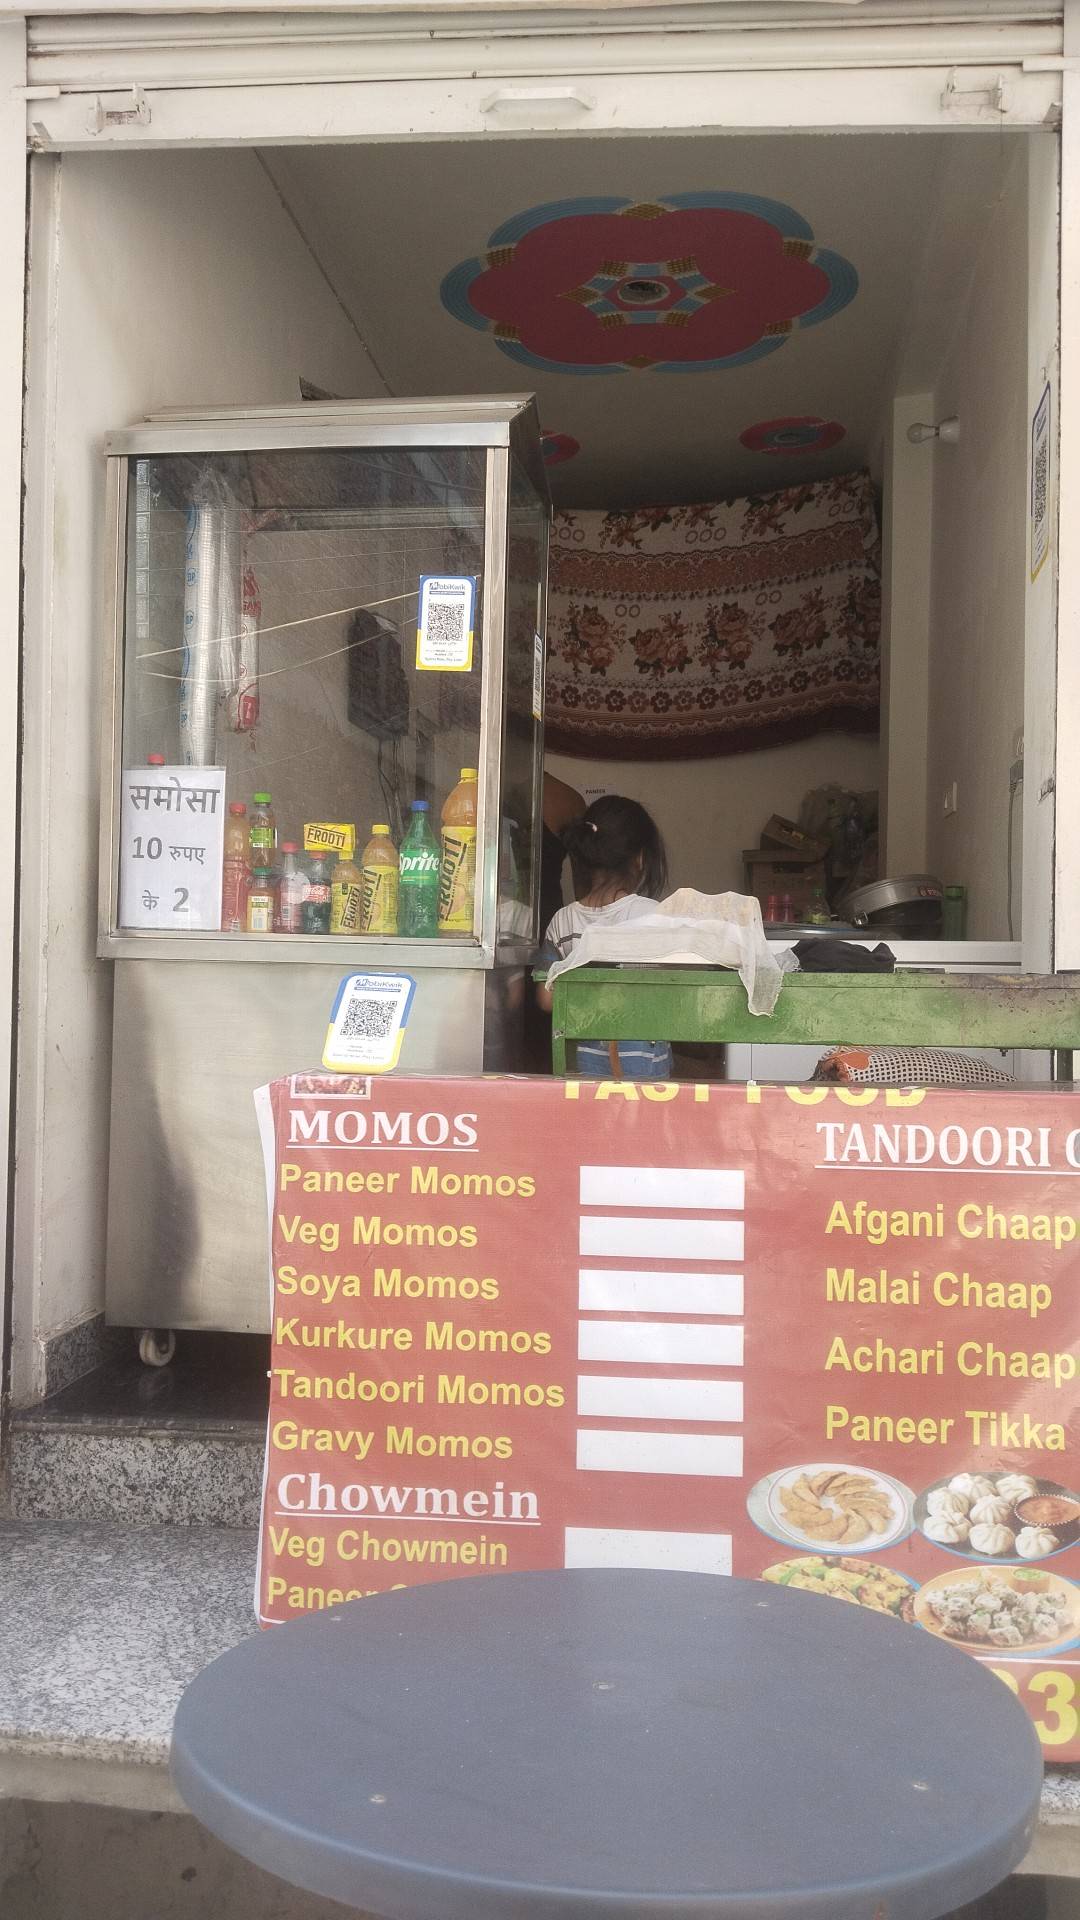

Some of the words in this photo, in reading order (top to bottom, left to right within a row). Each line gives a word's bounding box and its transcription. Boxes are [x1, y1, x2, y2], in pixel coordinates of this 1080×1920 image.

[129, 776, 220, 814] समोसा
[132, 837, 163, 860] 10
[169, 846, 206, 865] रुपए
[307, 828, 345, 847] FROOTI
[142, 890, 160, 910] के
[172, 887, 190, 912] 2
[288, 1110, 478, 1146] MOMOS
[815, 1122, 1051, 1167] TANDOORI
[279, 1163, 400, 1193] Paneer
[410, 1166, 536, 1198] Momos
[278, 1215, 340, 1252] Veg
[353, 1216, 477, 1249] Momos
[825, 1200, 944, 1245] Afgani
[957, 1202, 1077, 1250] Chaap
[276, 1266, 361, 1304] Soya
[373, 1268, 500, 1301] Momos
[826, 1267, 920, 1305] Malai
[933, 1271, 1052, 1318] Chaap
[275, 1317, 413, 1350] Kurkure
[425, 1321, 552, 1354] Momos
[825, 1336, 944, 1375] Achari
[957, 1341, 1077, 1388] Chaap
[273, 1368, 425, 1404] Tandoori
[437, 1375, 565, 1408] Momos
[272, 1420, 375, 1461] Gravy
[386, 1425, 513, 1459] Momos
[825, 1405, 954, 1445] Paneer
[964, 1410, 1067, 1451] Tikka
[276, 1472, 540, 1519] Chowmein
[268, 1526, 325, 1567] Veg
[336, 1530, 508, 1566] Chowmein
